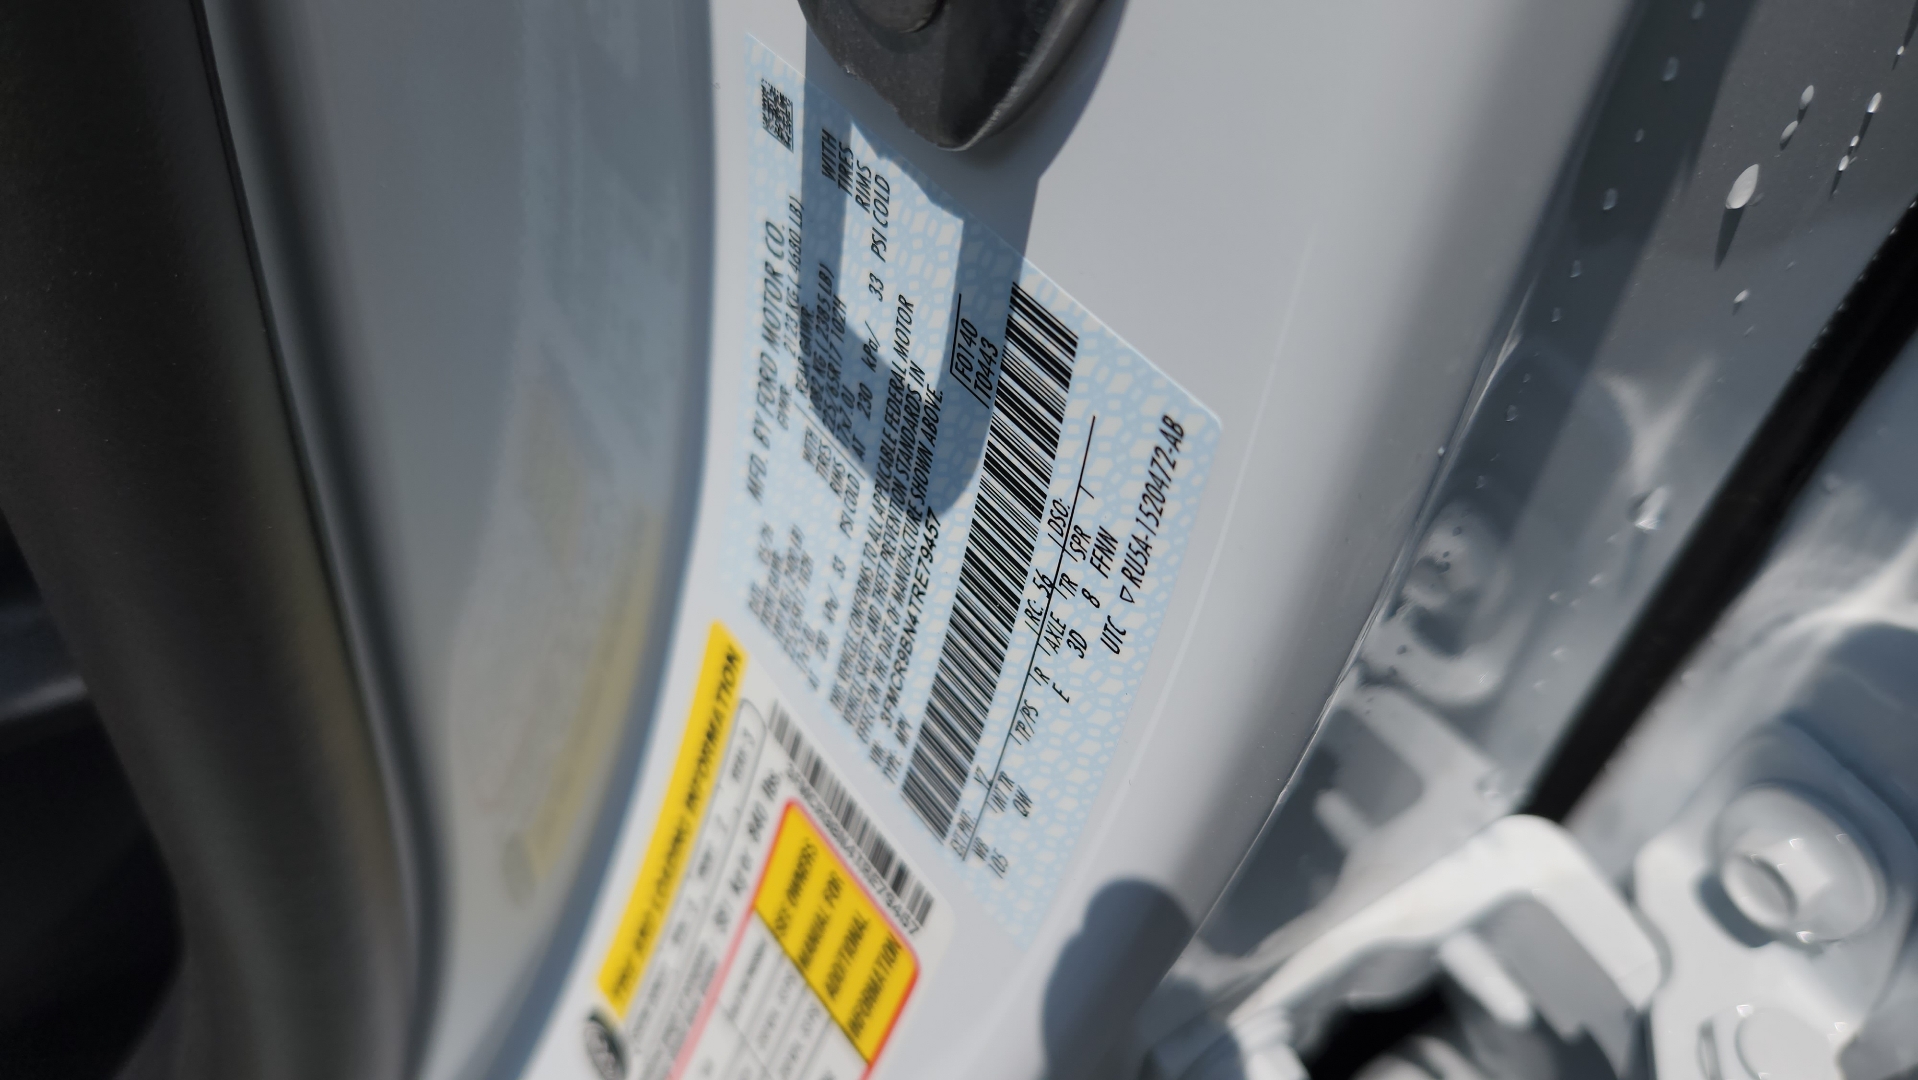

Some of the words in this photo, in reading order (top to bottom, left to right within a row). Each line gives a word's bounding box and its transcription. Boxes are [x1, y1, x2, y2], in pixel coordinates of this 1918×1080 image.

[821, 127, 837, 181] WITH
[837, 140, 853, 196] TIRES
[788, 193, 804, 230] LB)
[872, 172, 890, 230] COLD
[765, 218, 784, 261] CO.
[787, 227, 801, 275] 4680
[871, 226, 887, 263] PSI
[786, 284, 798, 315] KG
[818, 261, 834, 297] LB)
[869, 271, 884, 303] 33
[761, 259, 783, 354] MOTOR
[815, 292, 831, 342] 2385
[831, 294, 846, 343] 102H
[837, 383, 855, 451] 17x7.0J
[855, 158, 872, 214] RIMS
[799, 300, 813, 357] GAWR:
[862, 319, 880, 373] kPa/
[893, 292, 914, 363] MOTOR
[955, 316, 978, 382] F0140
[756, 348, 777, 418] FORD
[795, 354, 810, 399] REAR
[813, 349, 826, 378] KG
[908, 359, 926, 387] IN
[974, 335, 997, 400] T0443
[822, 341, 842, 434] 225/65R17
[857, 380, 873, 421] 230
[884, 362, 905, 433] FEDERAL
[752, 409, 771, 451] BY
[895, 383, 922, 481] STANDARDS
[920, 382, 943, 447] ABOVE.
[803, 424, 818, 465] WITH
[816, 438, 831, 482] TIRES
[852, 433, 866, 462] AT
[746, 449, 768, 504] MFD.
[830, 455, 845, 499] RIMS
[843, 470, 860, 516] COLD
[872, 426, 897, 519] APPLICABLE
[910, 440, 933, 505] SHOWN
[880, 475, 908, 567] PREVENTION
[1046, 494, 1070, 537] DSO:
[1120, 412, 1185, 588] RU5A-1520472-AB
[840, 508, 854, 540] PSI
[867, 515, 882, 547] ALL
[1068, 523, 1091, 560] SPR
[863, 540, 878, 565] TO
[889, 498, 922, 607] MANUFACTURE
[1090, 524, 1118, 579] FFNN
[848, 560, 874, 636] CONFORMS
[872, 561, 890, 607] THEFT
[1032, 568, 1054, 599] 56
[1058, 571, 1078, 596] TR
[1081, 586, 1100, 609] 8
[866, 602, 882, 637] AND
[880, 506, 941, 729] 3FMCR9BN4TRE79457
[886, 601, 900, 626] OF
[1042, 610, 1066, 654] AXLE
[1099, 613, 1126, 656] UTC
[836, 629, 858, 684] VEHICLE
[855, 629, 875, 681] SAFETY
[878, 619, 896, 659] DATE
[1066, 627, 1088, 659] 3D
[872, 653, 888, 683] THE
[1033, 665, 1050, 684] R
[830, 680, 844, 710] THIS
[842, 672, 864, 726] VEHICLE
[867, 678, 881, 705] ON
[1051, 682, 1070, 703] E
[684, 643, 742, 817] INFORMATION
[894, 712, 912, 748] MPV
[1014, 697, 1039, 743] TP/PS
[990, 783, 1009, 812] INT
[997, 769, 1014, 790] TR
[1011, 785, 1032, 818] QW
[949, 828, 967, 857] EXT
[973, 765, 992, 790] YZ
[971, 836, 989, 861] WB
[988, 848, 1008, 879] 105
[822, 868, 844, 909] FOR
[822, 905, 869, 1002] ADDITIONAL
[846, 929, 901, 1041] INFORMATION
